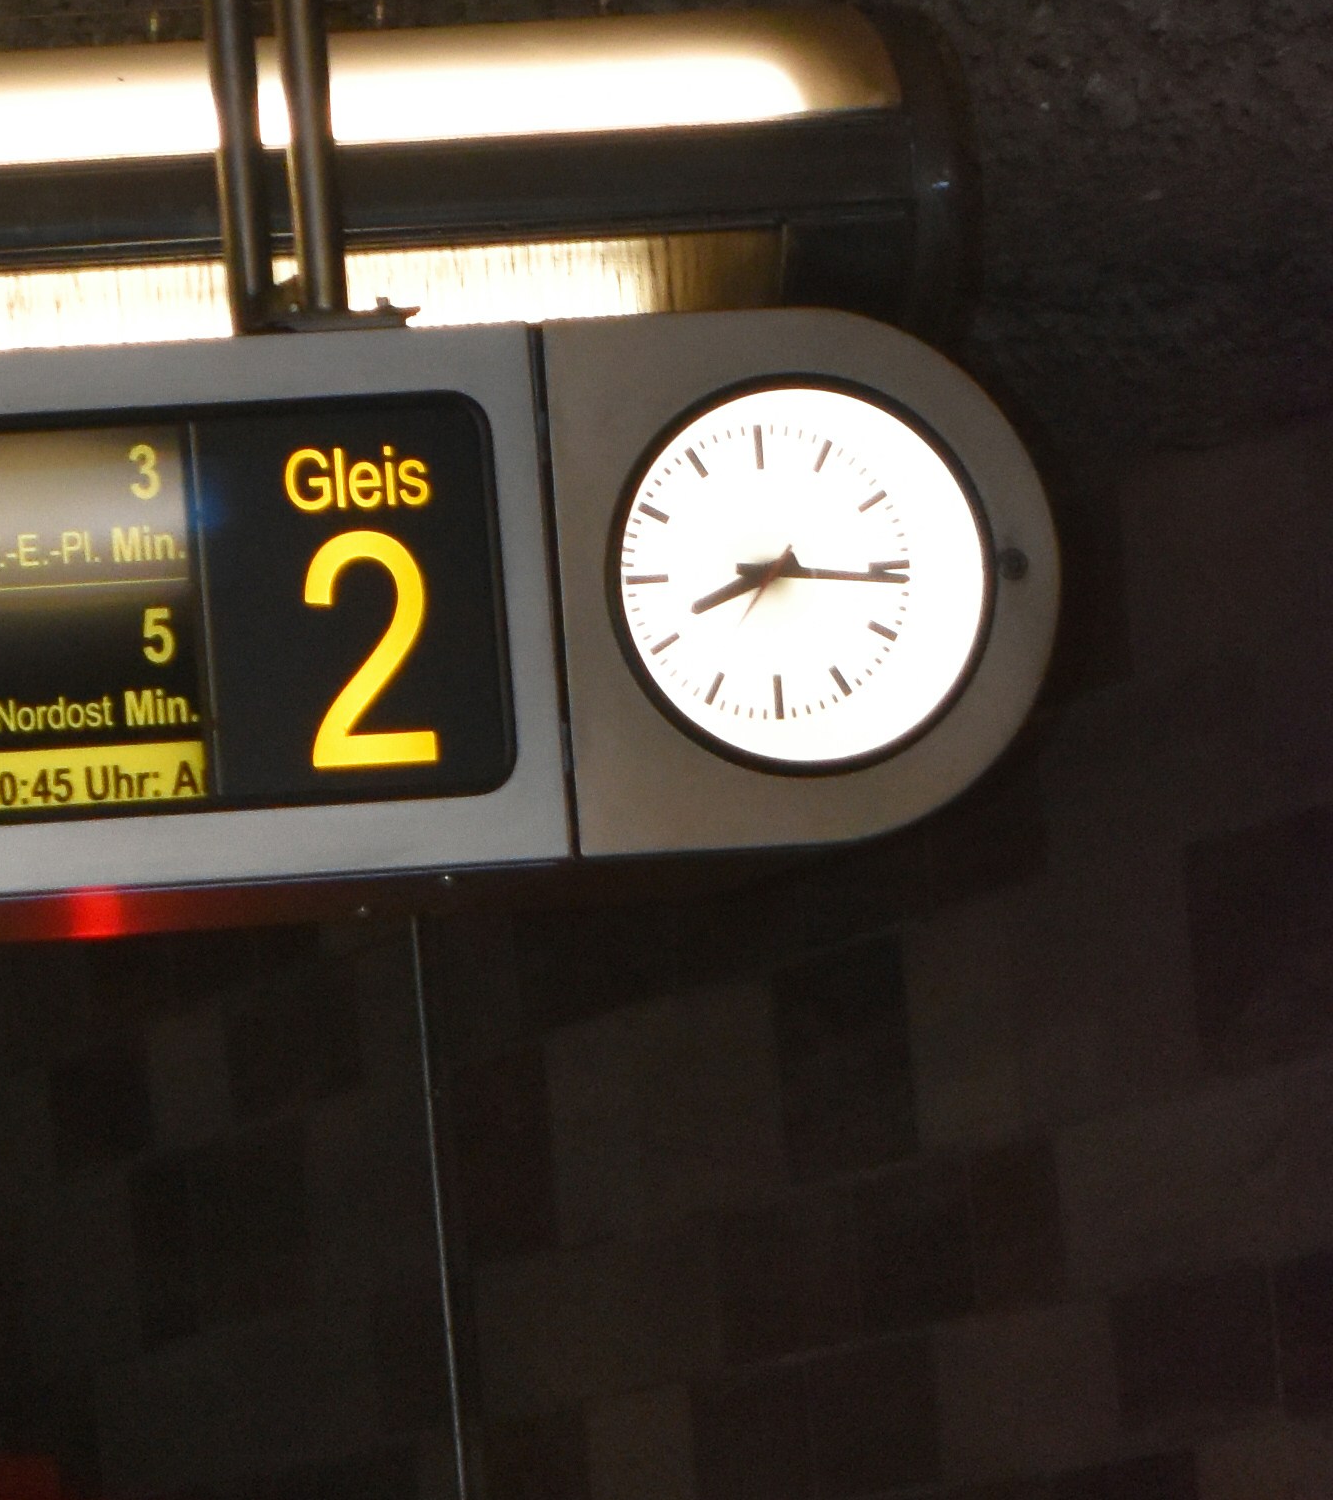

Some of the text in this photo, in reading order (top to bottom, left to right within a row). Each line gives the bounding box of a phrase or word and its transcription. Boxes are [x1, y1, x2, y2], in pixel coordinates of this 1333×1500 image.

[128, 443, 162, 500] 3
[284, 445, 430, 512] Gleis
[111, 524, 187, 564] Min.
[141, 607, 177, 666] 5
[304, 529, 439, 770] 2
[123, 688, 201, 727] Min.
[84, 763, 162, 802] Uhr:
